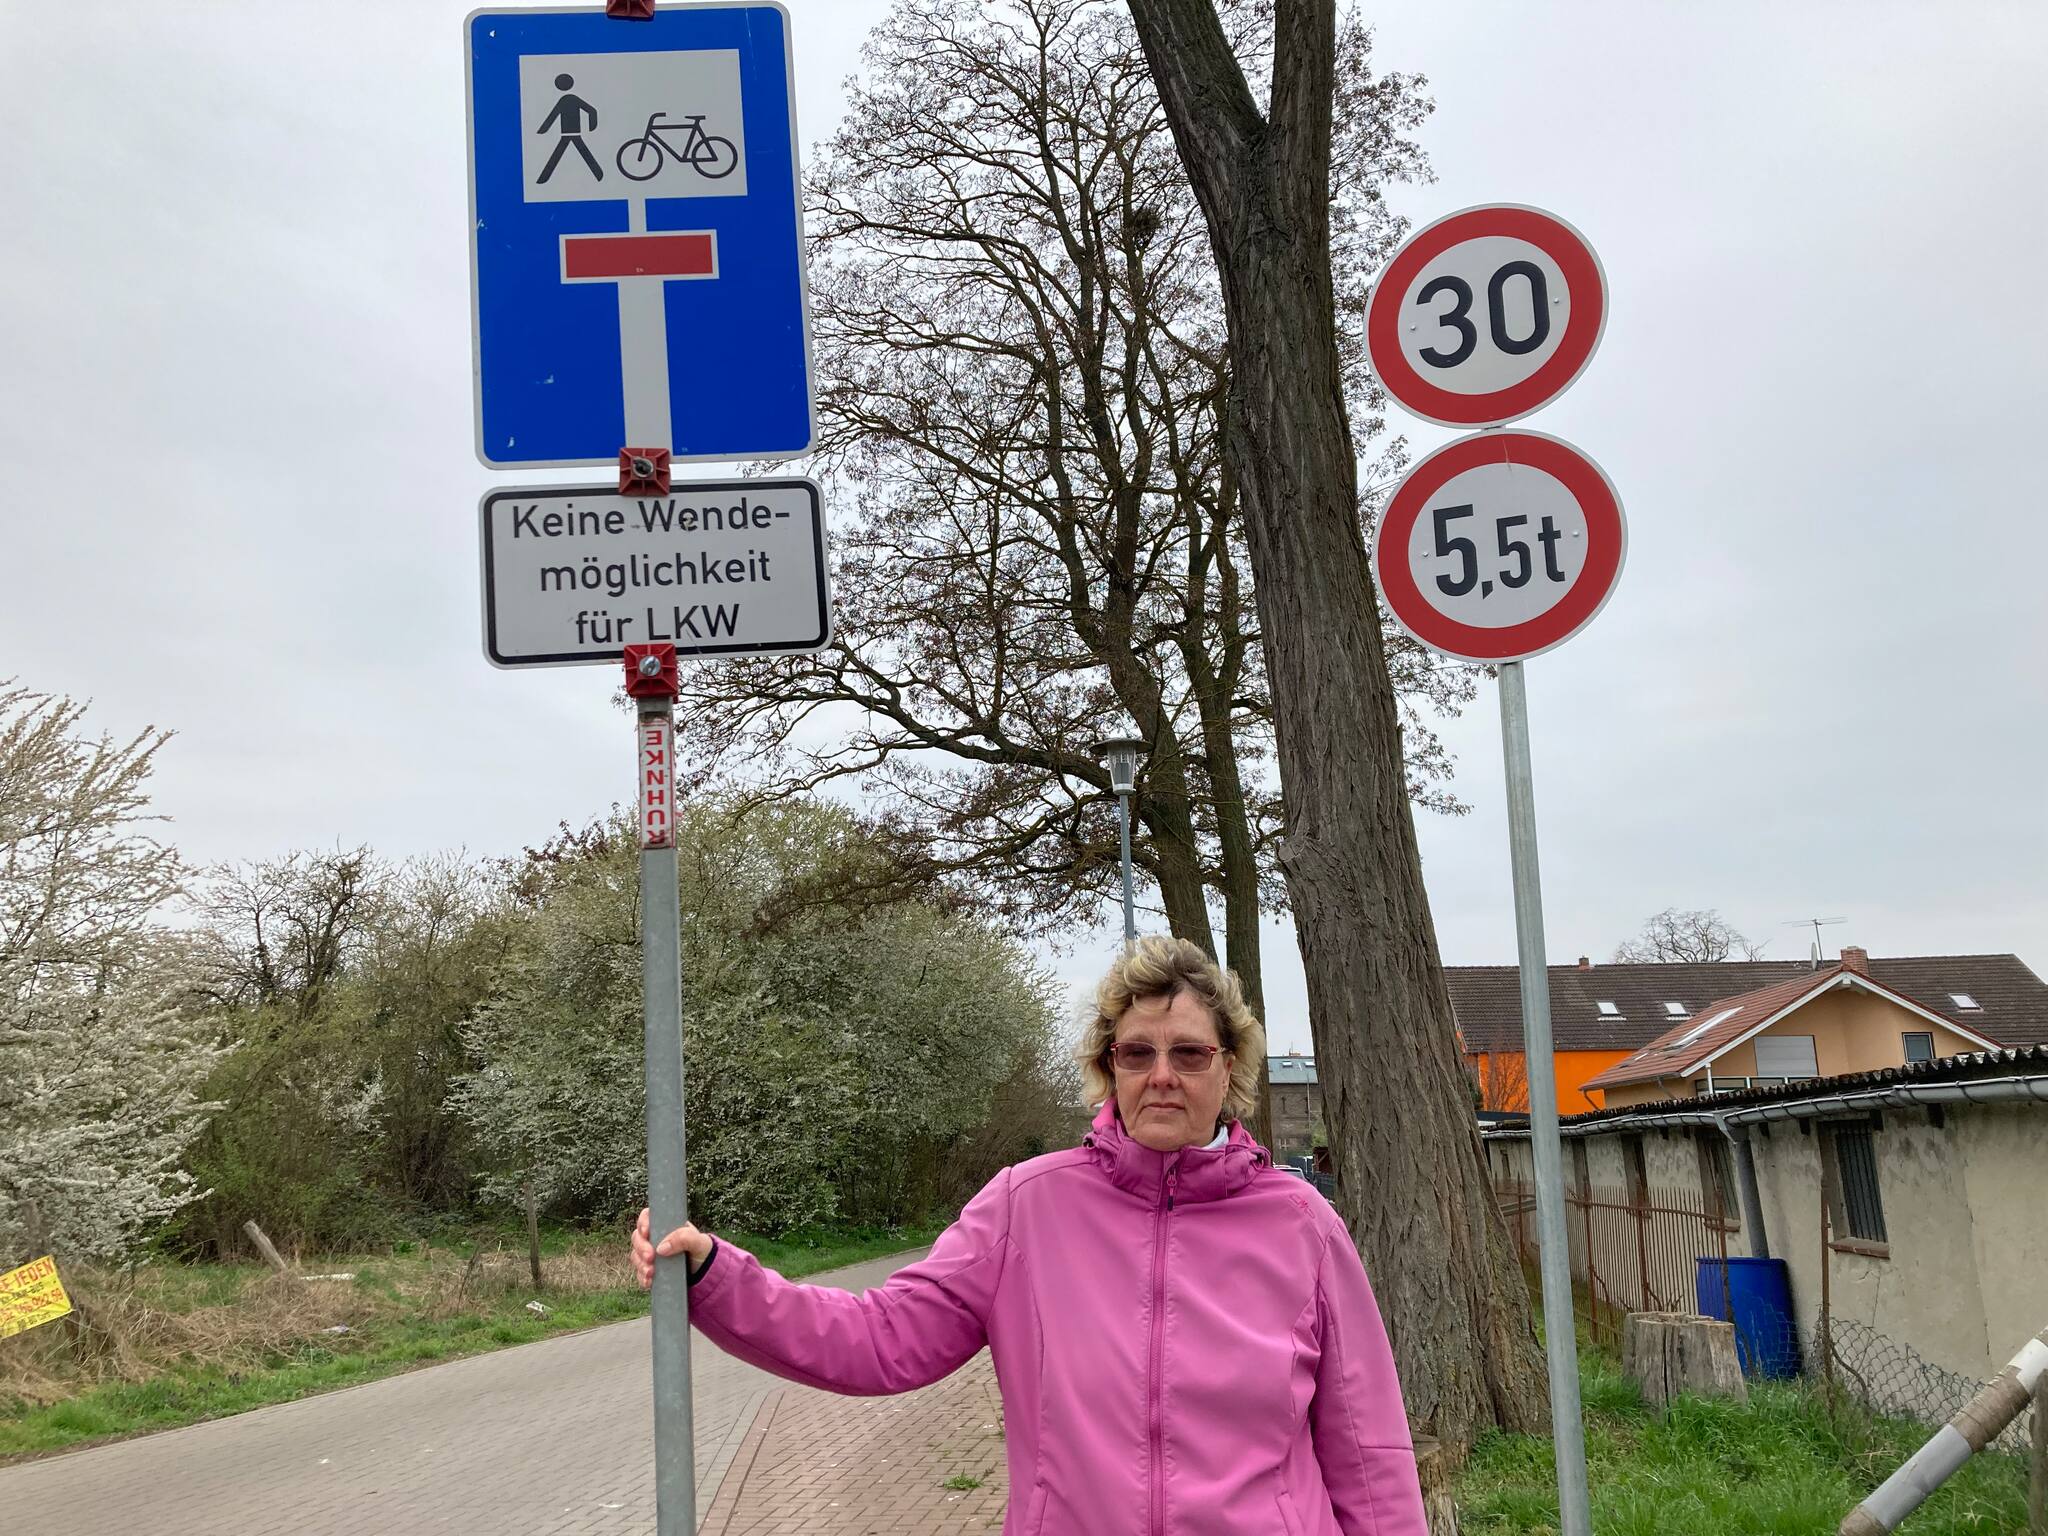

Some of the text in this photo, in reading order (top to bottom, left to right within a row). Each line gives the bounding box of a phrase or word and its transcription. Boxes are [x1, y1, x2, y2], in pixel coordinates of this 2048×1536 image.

[1415, 260, 1551, 369] 30
[512, 497, 791, 539] Keine Wende-
[540, 549, 772, 598] möglichkeit
[1432, 503, 1566, 600] 5,5t
[575, 603, 740, 644] für LKW
[645, 730, 666, 845] RUHNKE
[14, 1257, 54, 1288] JEDEN
